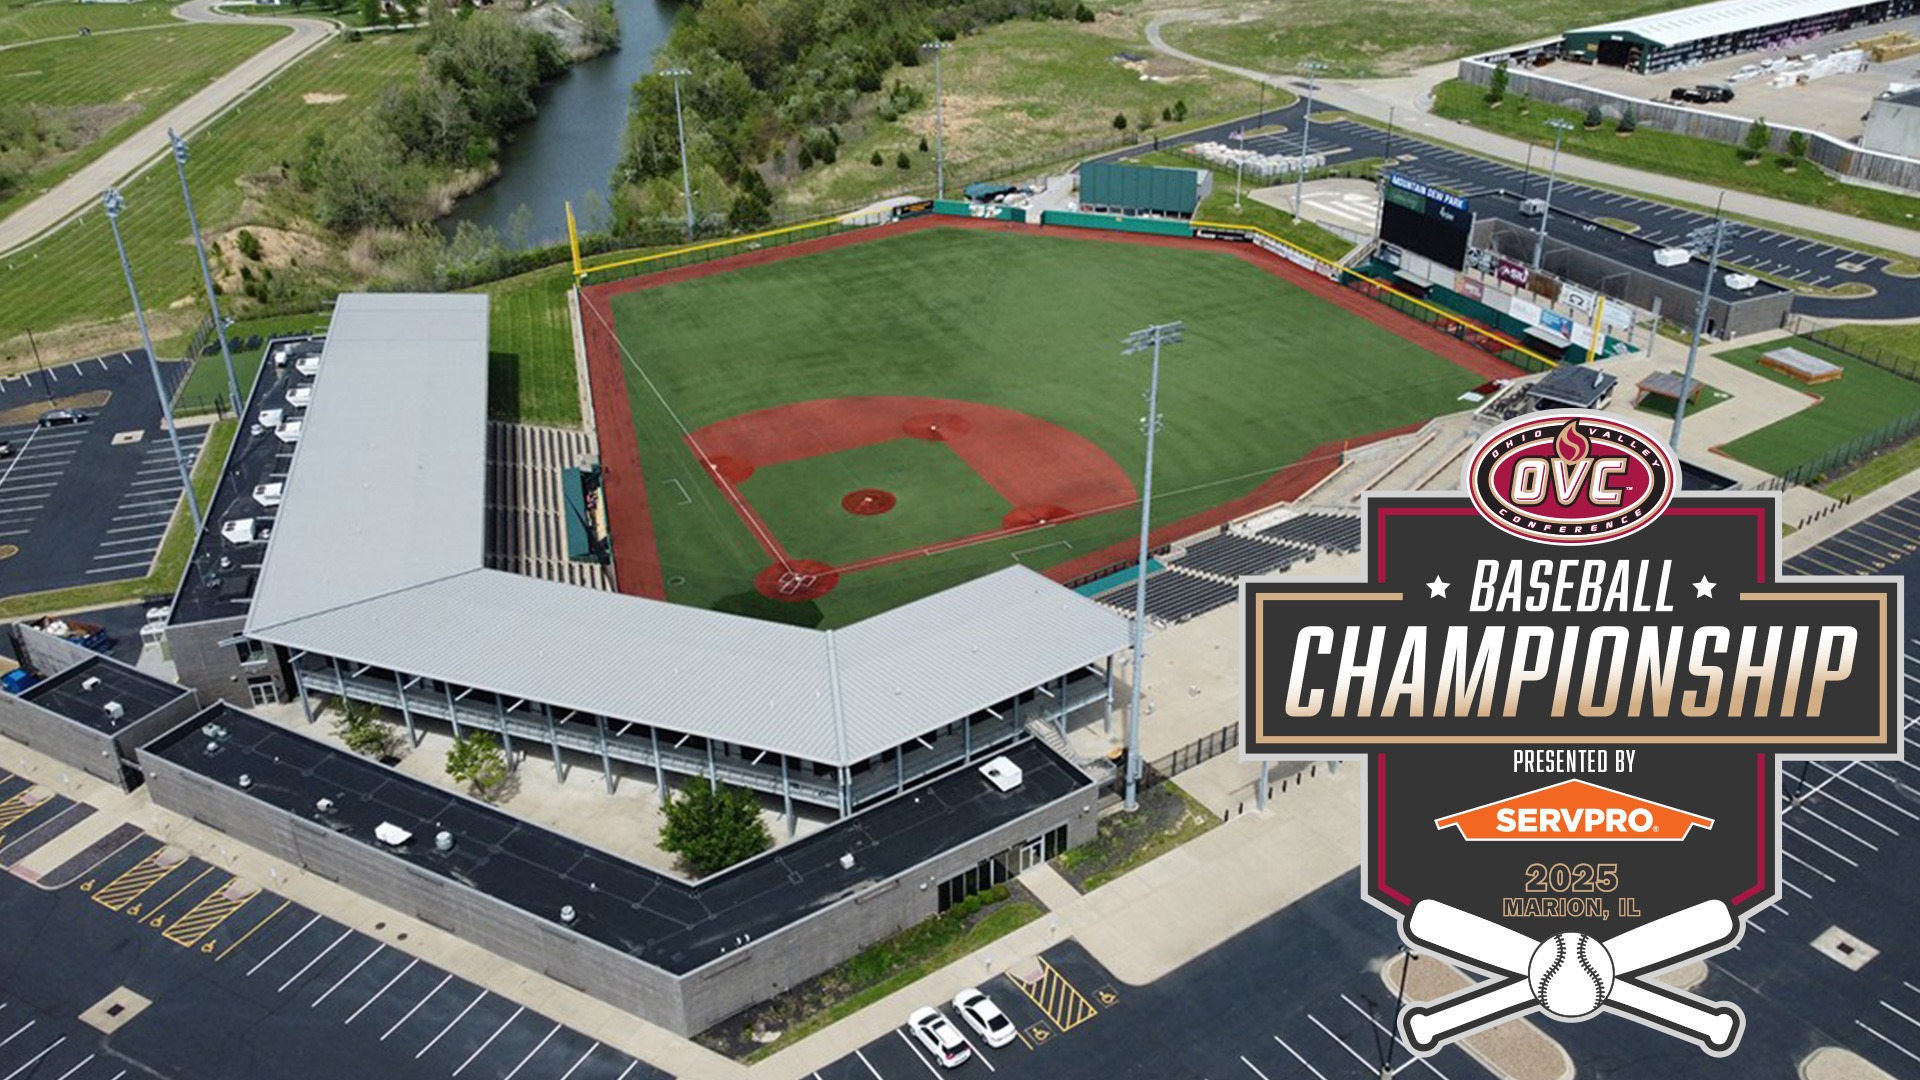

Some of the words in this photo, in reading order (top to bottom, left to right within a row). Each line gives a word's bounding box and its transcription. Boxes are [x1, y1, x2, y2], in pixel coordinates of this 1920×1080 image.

[1391, 175, 1427, 195] MOUNTAIN
[1427, 188, 1444, 201] DEW
[1444, 194, 1464, 209] PARK
